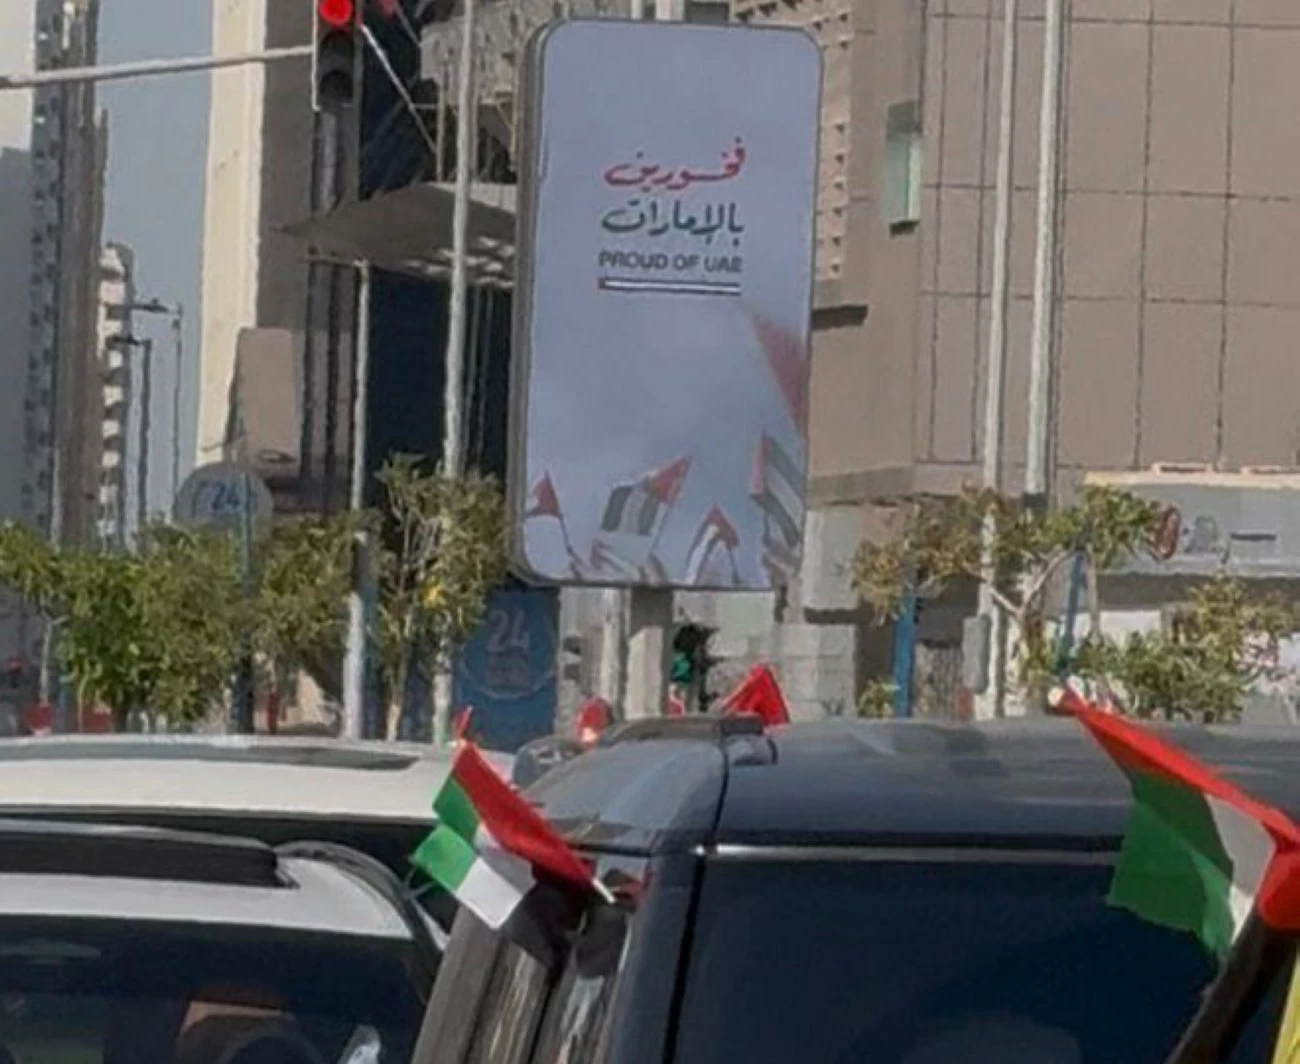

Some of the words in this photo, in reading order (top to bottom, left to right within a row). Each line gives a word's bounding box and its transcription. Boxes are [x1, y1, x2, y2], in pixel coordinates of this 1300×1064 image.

[604, 136, 746, 193] فخورين
[599, 251, 669, 270] PROUD
[673, 254, 700, 271] OF
[703, 256, 744, 274] UAE
